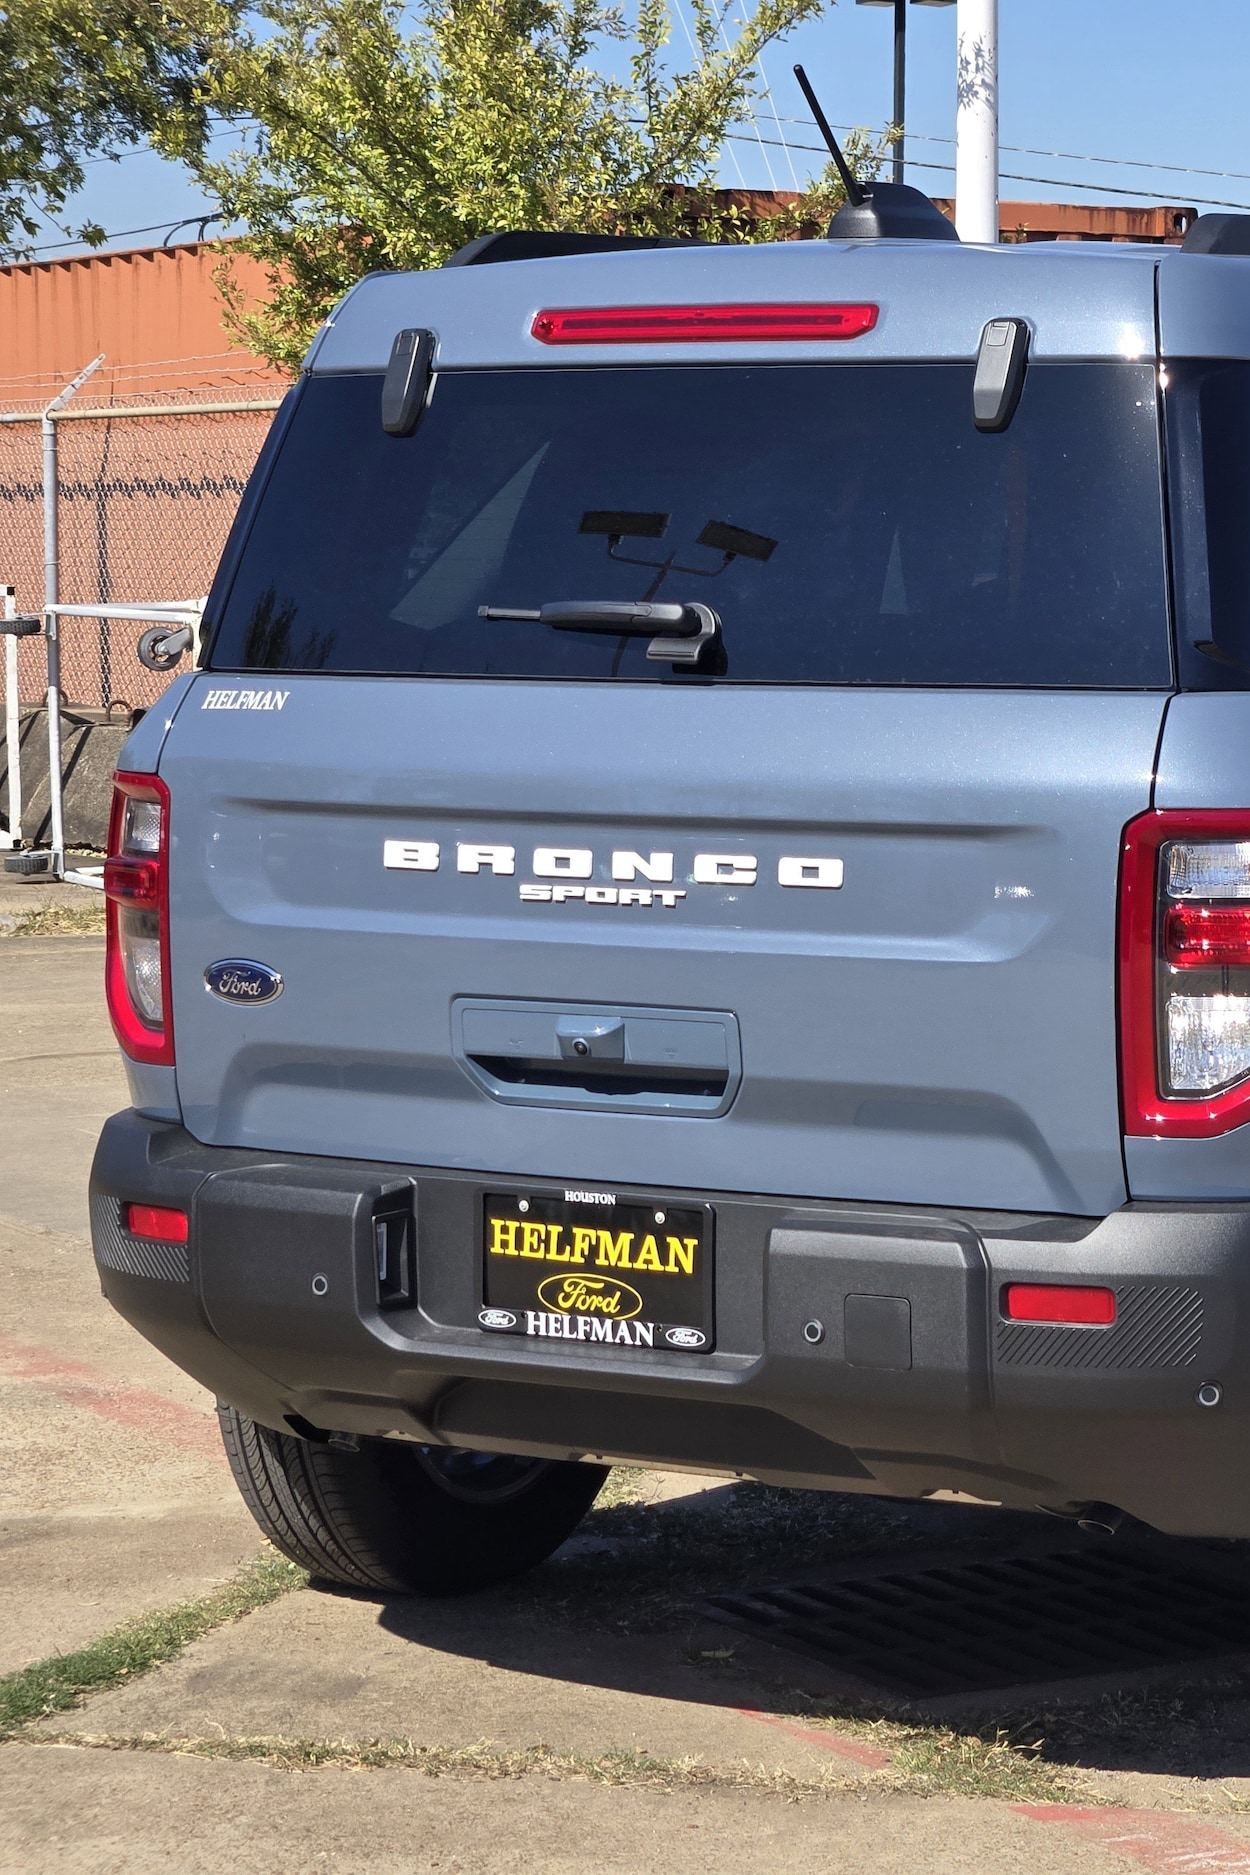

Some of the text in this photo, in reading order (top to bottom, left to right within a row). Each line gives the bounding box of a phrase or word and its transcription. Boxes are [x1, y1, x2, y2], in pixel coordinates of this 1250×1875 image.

[201, 690, 290, 710] HELFMAN
[383, 840, 843, 888] BRONCO
[519, 884, 686, 907] SPORT
[219, 969, 262, 995] Ford
[564, 1190, 616, 1205] HOUSTON
[490, 1218, 698, 1274] HELFMAN
[557, 1278, 621, 1314] Ford
[484, 1311, 509, 1325] Ford
[526, 1310, 654, 1347] HELFMAN
[672, 1330, 698, 1344] Ford
